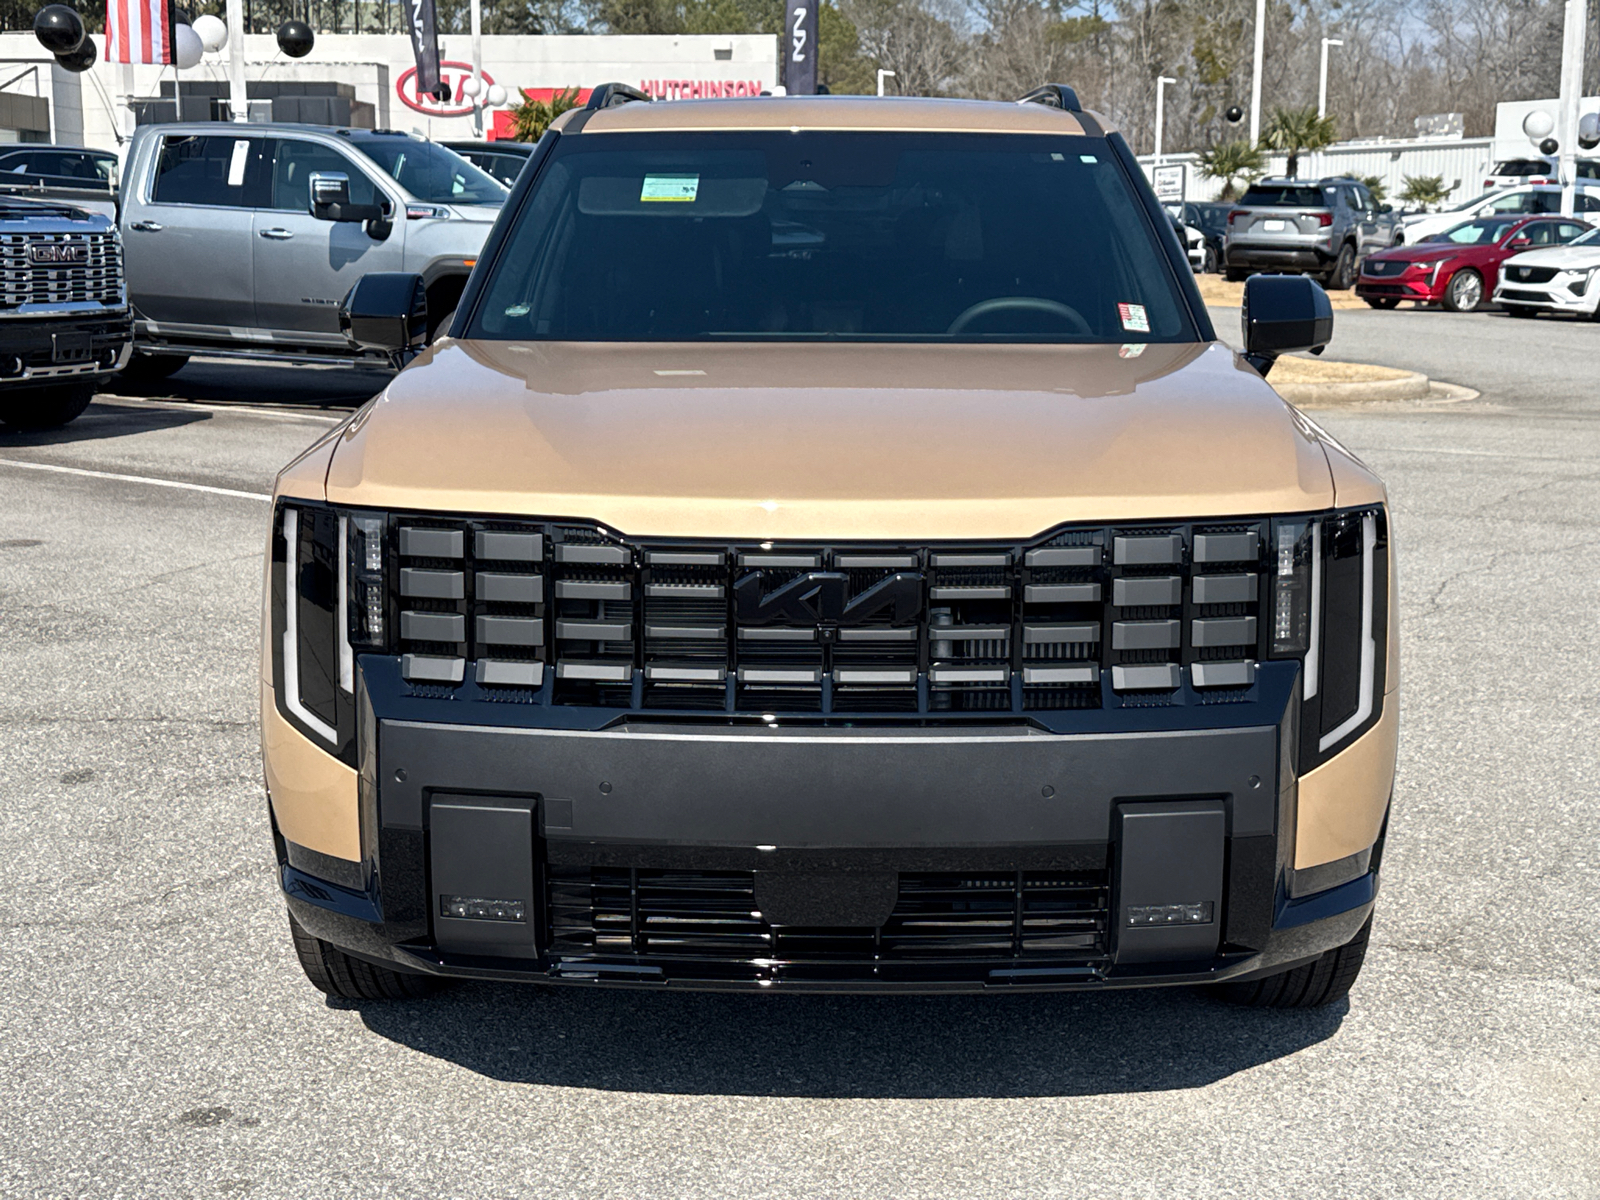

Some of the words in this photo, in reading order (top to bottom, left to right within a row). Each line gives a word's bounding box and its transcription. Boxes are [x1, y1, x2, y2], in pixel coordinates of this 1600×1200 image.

[640, 79, 762, 98] HUTCHINSON
[32, 245, 89, 262] GMC
[733, 570, 926, 626] KIA
